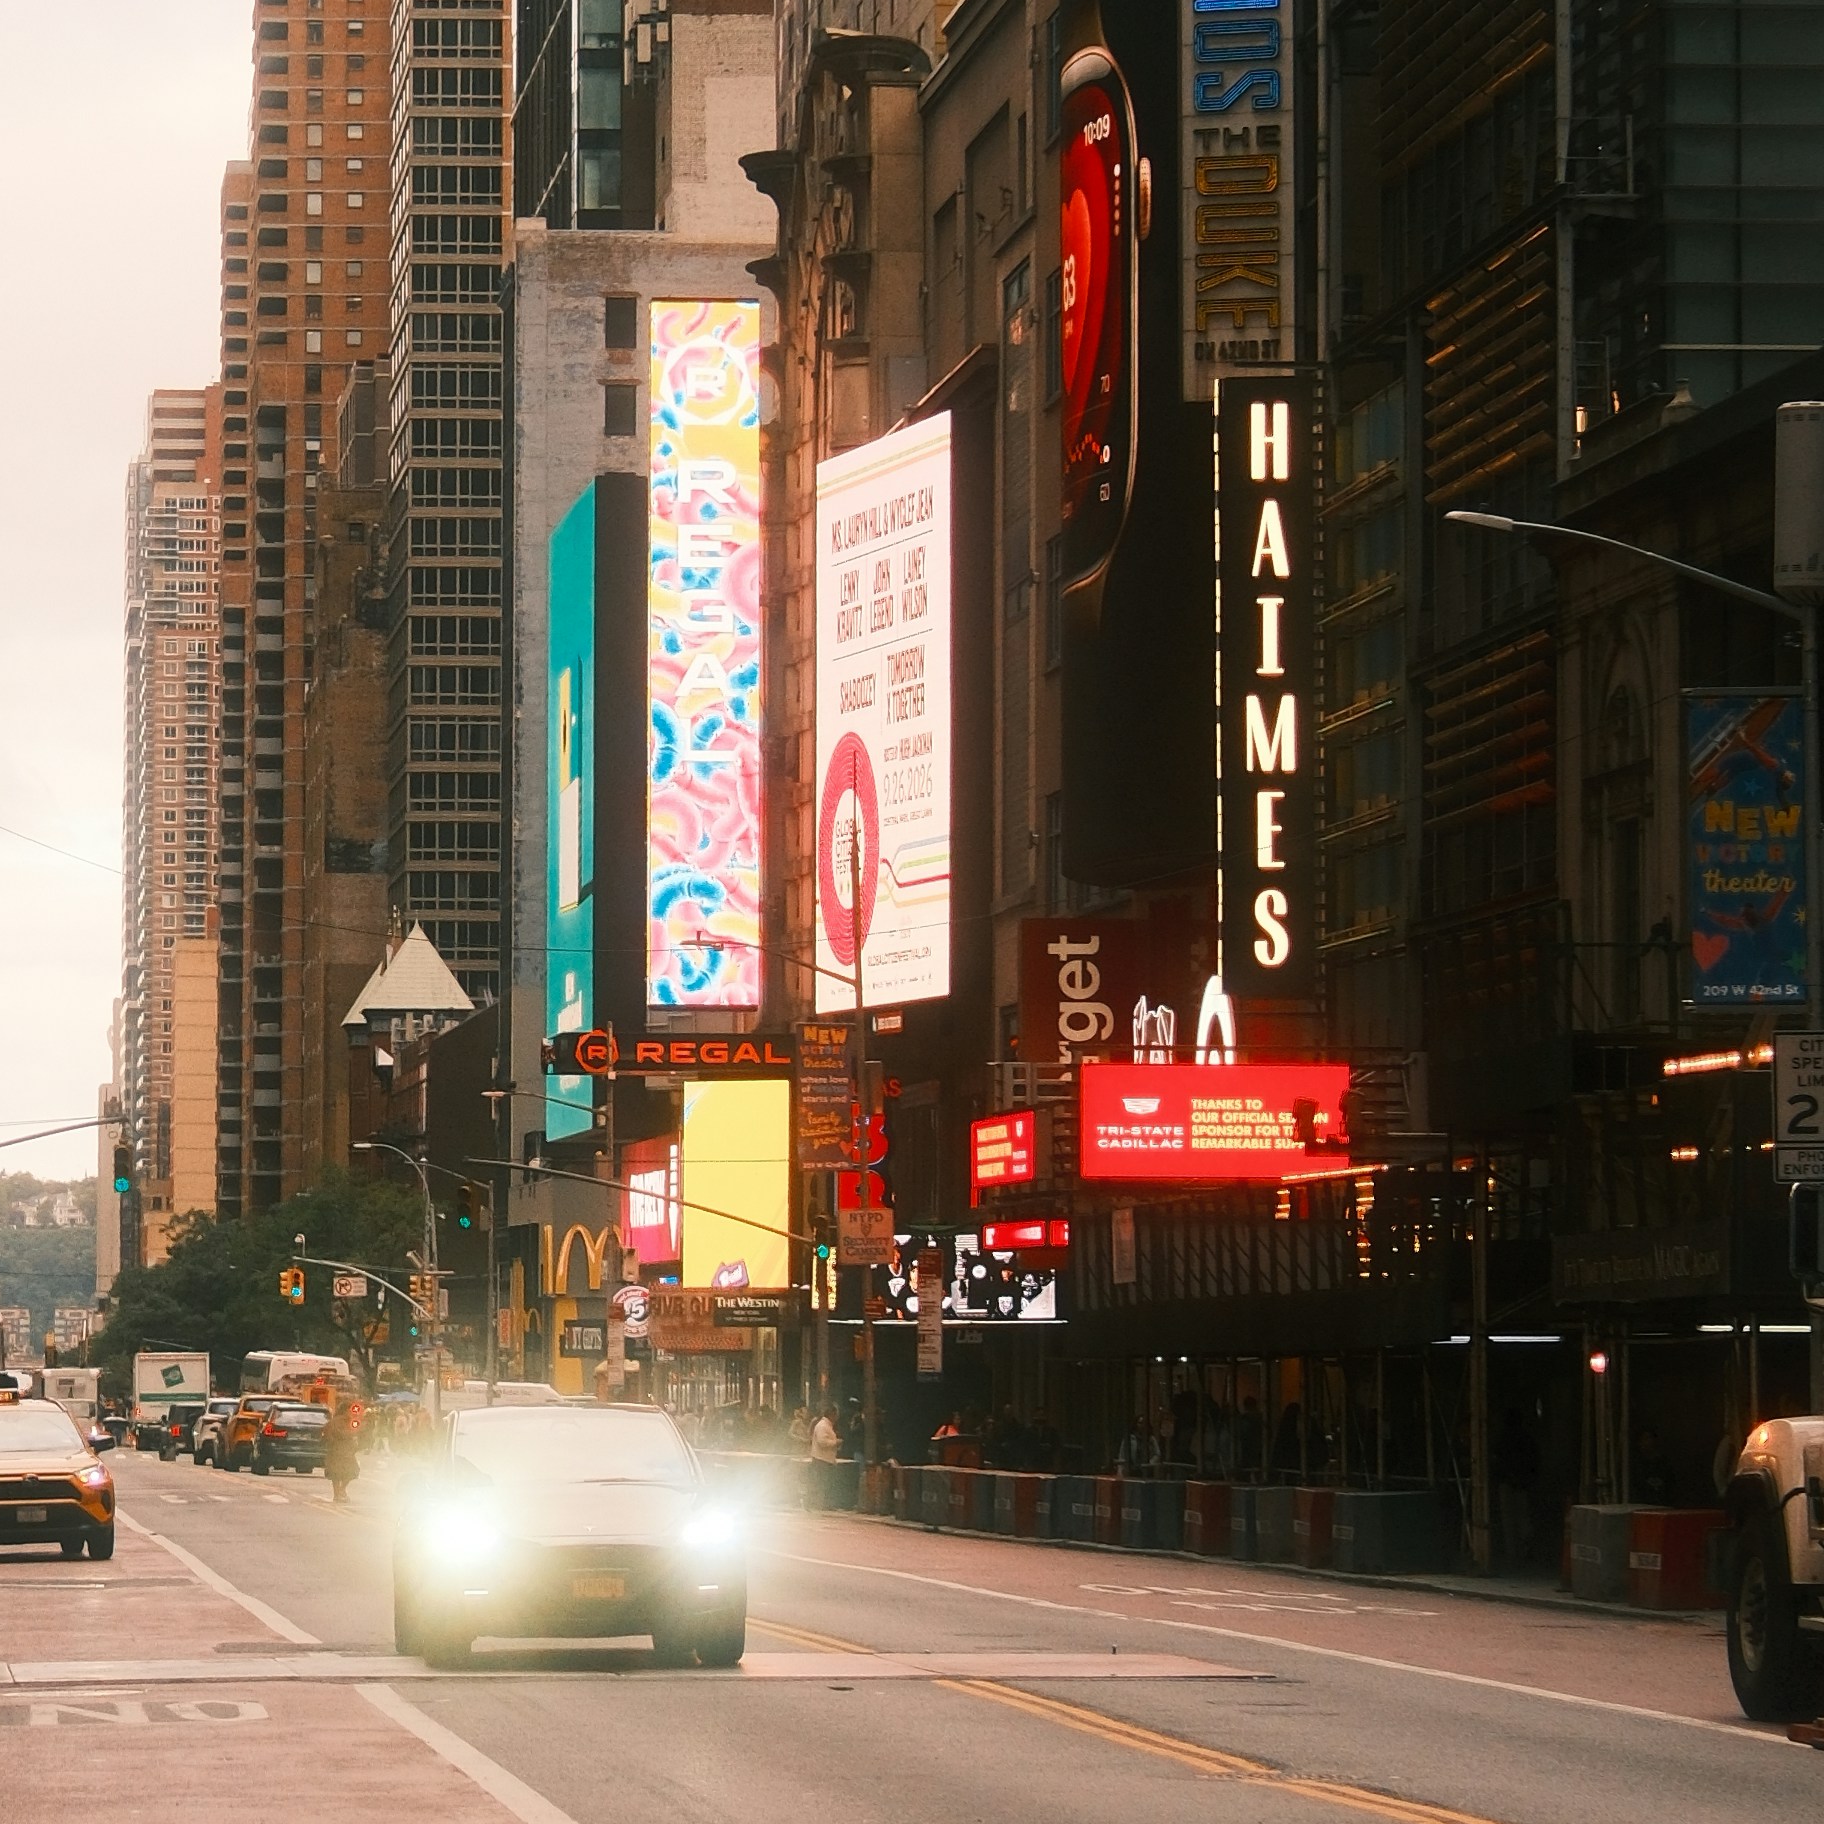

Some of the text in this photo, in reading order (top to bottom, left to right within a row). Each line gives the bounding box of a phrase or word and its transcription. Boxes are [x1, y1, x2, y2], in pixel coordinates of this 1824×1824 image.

[1082, 113, 1110, 146] 10:09
[1194, 125, 1281, 152] THE
[1195, 154, 1280, 334] DUKE
[843, 509, 868, 550] LAURYN
[889, 492, 916, 533] WYCLEF
[916, 484, 934, 524] JEAN
[840, 545, 926, 607] LENNY JOHN LAINEY
[675, 459, 738, 764] REGAL
[836, 581, 928, 644] KRAVITZ LEGEND WILSON
[886, 644, 925, 688] TOMORROW
[1243, 400, 1299, 968] HAIMES
[883, 762, 933, 807] 9.26.2026
[1703, 799, 1802, 841] NEW
[1702, 868, 1797, 894] theater
[1703, 984, 1800, 997] 209 W 42nd St
[803, 1025, 848, 1045] NEW
[635, 1041, 791, 1064] REGAL
[1191, 1099, 1263, 1110] THANKS TO
[1191, 1112, 1219, 1123] OUR
[1222, 1112, 1275, 1123] OFFICIAL
[1097, 1126, 1184, 1135] TRI-STATE
[1191, 1125, 1252, 1136] SPONSOR
[1255, 1125, 1280, 1136] FOR
[1097, 1139, 1184, 1148] CADILLAC
[1191, 1138, 1272, 1149] REMARKABLE
[848, 1212, 884, 1224] NYPD
[843, 1236, 891, 1248] SECURITY
[845, 1247, 888, 1257] CAMERA
[715, 1296, 780, 1309] THE WESTIN
